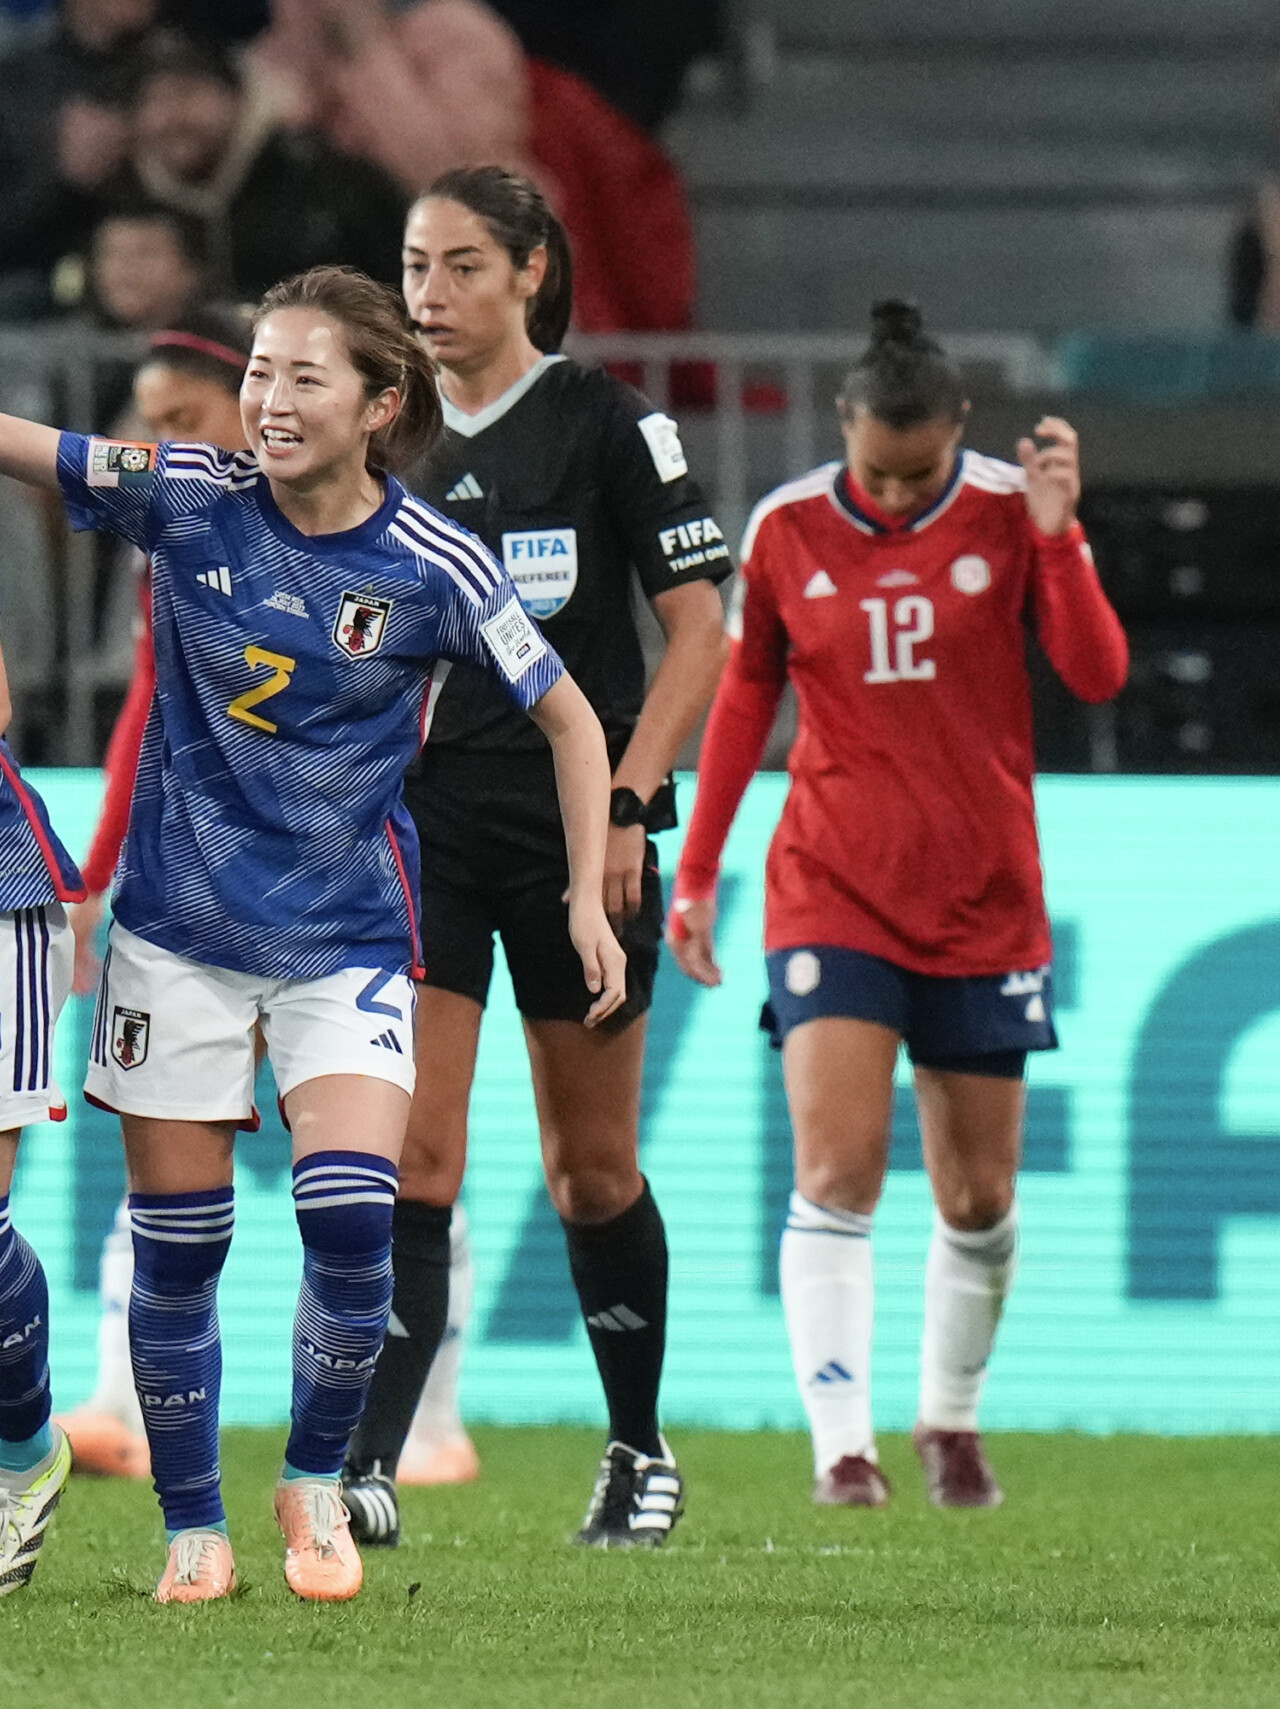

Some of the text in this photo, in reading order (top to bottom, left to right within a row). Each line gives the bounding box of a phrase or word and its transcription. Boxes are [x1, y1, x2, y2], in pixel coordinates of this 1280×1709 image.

[657, 516, 724, 557] FIFA
[511, 537, 569, 560] FIFA
[668, 550, 706, 573] TEAM
[513, 571, 570, 584] REFEREE
[353, 595, 380, 607] JAPAN
[500, 618, 526, 646] UNITES
[860, 594, 937, 684] 12
[226, 644, 297, 734] 2
[121, 1008, 142, 1019] JAPAN
